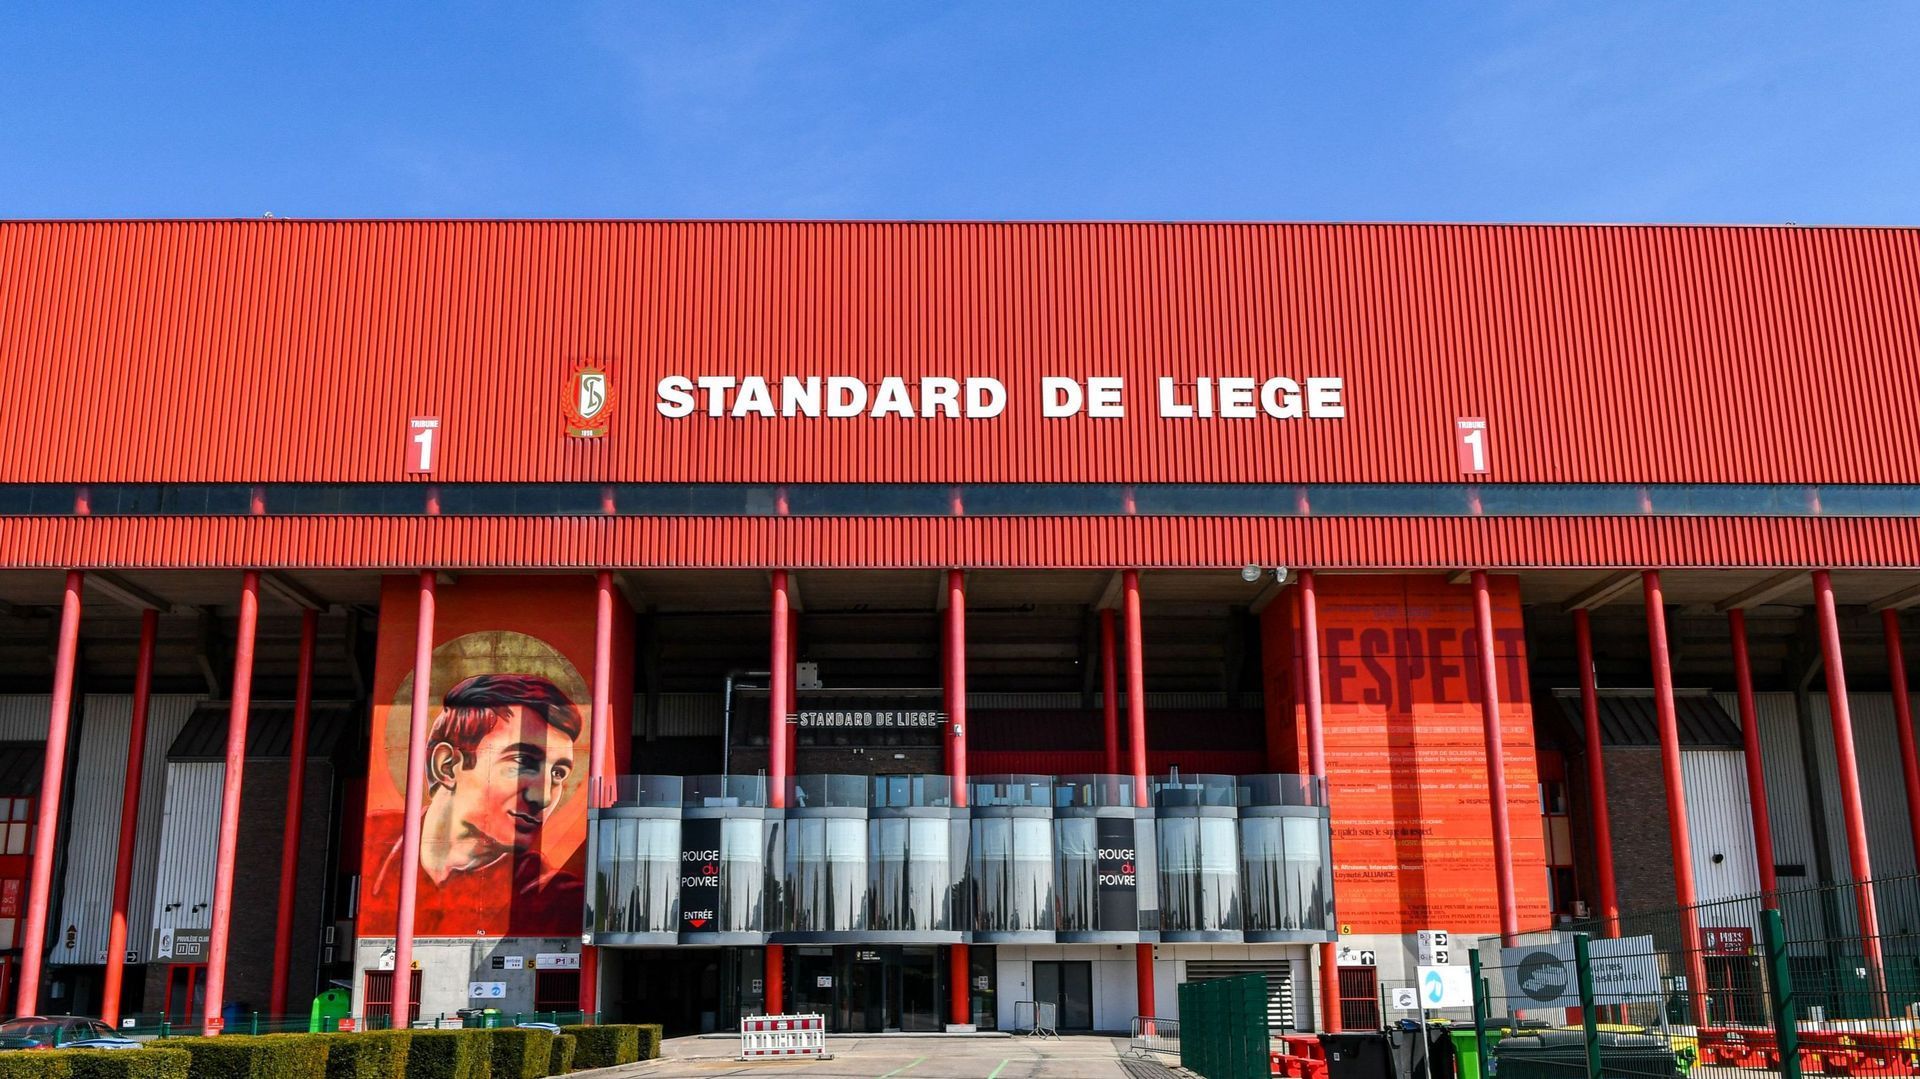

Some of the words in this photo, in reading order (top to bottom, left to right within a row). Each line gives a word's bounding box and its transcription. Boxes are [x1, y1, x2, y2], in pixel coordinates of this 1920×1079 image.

[656, 375, 1007, 418] STANDARD
[1042, 376, 1125, 418] DE
[1158, 376, 1345, 419] LIEGE
[414, 429, 433, 470] 1
[1463, 429, 1485, 470] 1
[800, 712, 872, 726] STANDARD
[876, 712, 893, 726] DE
[897, 712, 936, 726] LIEGE
[682, 850, 719, 861] ROUGE
[1098, 849, 1135, 860] ROUGE
[702, 862, 719, 875] du
[1121, 861, 1135, 874] du
[681, 876, 718, 887] POIVRE
[1099, 875, 1135, 886] POIVRE
[684, 909, 713, 919] ENTRÉE
[528, 960, 535, 968] 5
